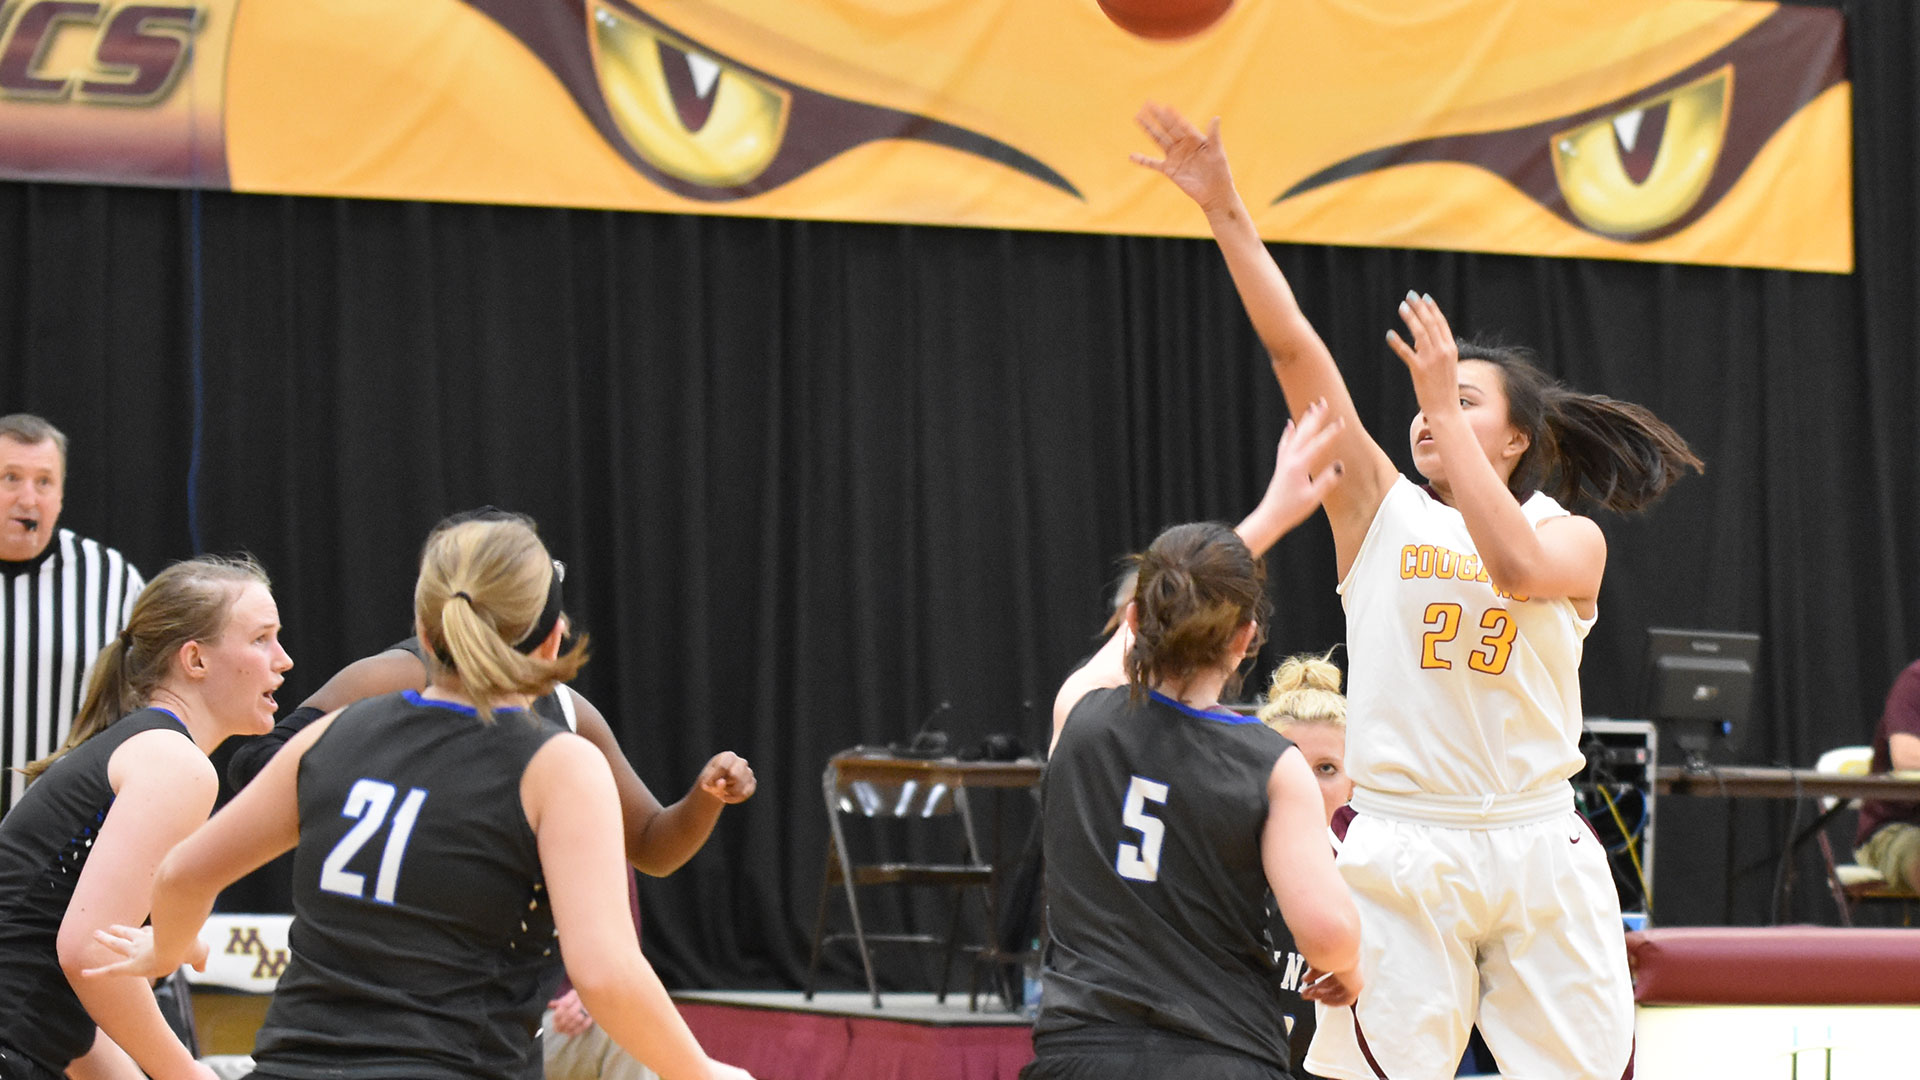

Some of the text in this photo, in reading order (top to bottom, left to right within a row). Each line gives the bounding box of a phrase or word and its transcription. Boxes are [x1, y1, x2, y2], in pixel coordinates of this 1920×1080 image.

[0, 0, 203, 104] CS
[1400, 544, 1530, 602] COUG
[1420, 602, 1518, 676] 23
[319, 777, 430, 905] 21
[1115, 774, 1171, 882] 5
